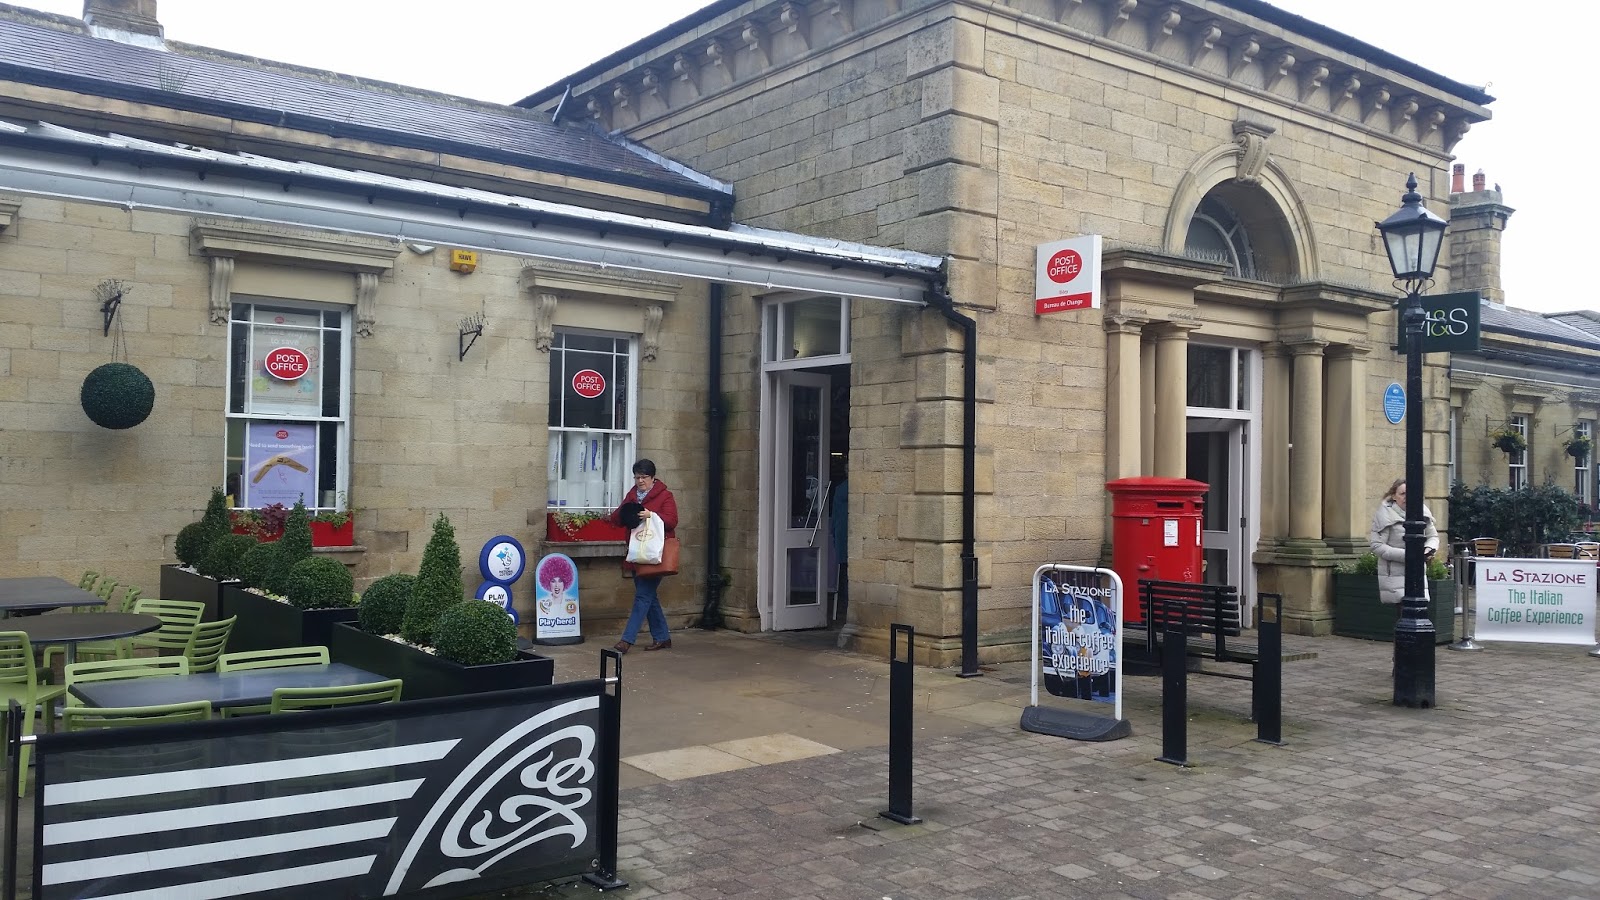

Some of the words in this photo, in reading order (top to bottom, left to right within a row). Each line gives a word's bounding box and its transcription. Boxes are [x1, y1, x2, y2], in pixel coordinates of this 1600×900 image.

[1055, 255, 1075, 266] POST
[1050, 264, 1078, 276] OFFICE
[276, 354, 300, 363] POST
[270, 362, 303, 371] OFFICE
[580, 376, 598, 384] POST
[576, 382, 601, 391] OFFICE
[1508, 589, 1526, 604] The
[1530, 590, 1563, 605] Italian
[1070, 604, 1086, 623] the
[1488, 608, 1522, 624] Coffee
[1526, 609, 1584, 625] Experience
[539, 618, 555, 627] Play
[556, 617, 576, 625] here!
[1045, 626, 1076, 646] italian
[1080, 632, 1113, 651] coffee
[1052, 653, 1109, 672] experience
